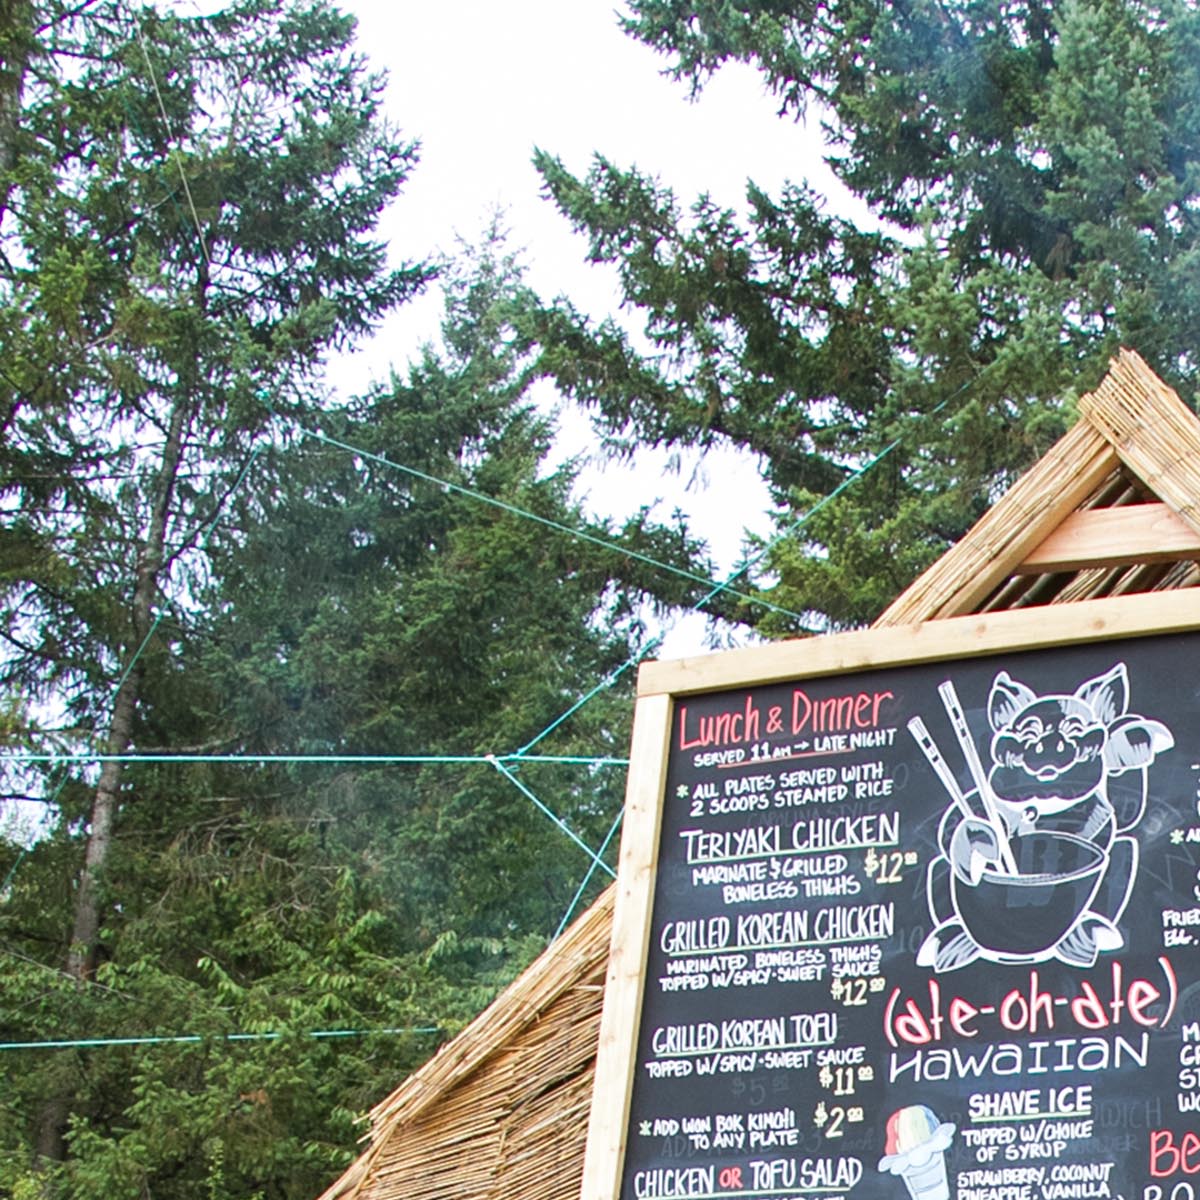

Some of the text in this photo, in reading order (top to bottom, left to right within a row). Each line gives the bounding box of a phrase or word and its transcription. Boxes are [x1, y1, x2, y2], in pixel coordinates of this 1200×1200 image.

[680, 690, 894, 750] Lunch & Dinner
[694, 749, 744, 767] SERVED
[814, 735, 846, 751] LATE
[850, 728, 897, 749] NIGHT
[725, 774, 775, 797] PLATES
[780, 768, 836, 790] SERVED
[842, 762, 884, 782] WITH
[690, 802, 704, 817] 2
[709, 795, 769, 813] SCOOPS
[774, 785, 848, 808] STEAMED
[856, 780, 893, 798] RICE
[680, 825, 780, 862] TERIYAKI
[792, 812, 900, 850] CHICKEN
[692, 861, 768, 886] MARINATE
[782, 855, 848, 876] GRILLED
[723, 874, 861, 904] BONELESS THIGHS
[661, 902, 894, 952] GRILLED KOREAN CHICKEN
[667, 944, 882, 975] MARINATED BONELESS THIGHS
[660, 962, 880, 992] TOPPED SAUCE
[652, 1012, 838, 1054] GRILLED KOREAN TOFU
[646, 1046, 866, 1078] TOPPED SAUCE
[968, 1089, 1040, 1116] SHAVE
[1050, 1086, 1092, 1114] ICE
[682, 1116, 711, 1133] WON
[716, 1114, 743, 1131] BOK
[961, 1126, 1017, 1147] TOPPED
[689, 1133, 710, 1150] TO
[714, 1132, 745, 1148] ANY
[750, 1129, 799, 1146] PLATE
[976, 1141, 1068, 1162] OF SYRUP
[634, 1156, 863, 1198] CHICKEN OR TOFU SALAD
[1051, 1163, 1114, 1182] COCONUT
[1042, 1182, 1110, 1200] VANILLA
